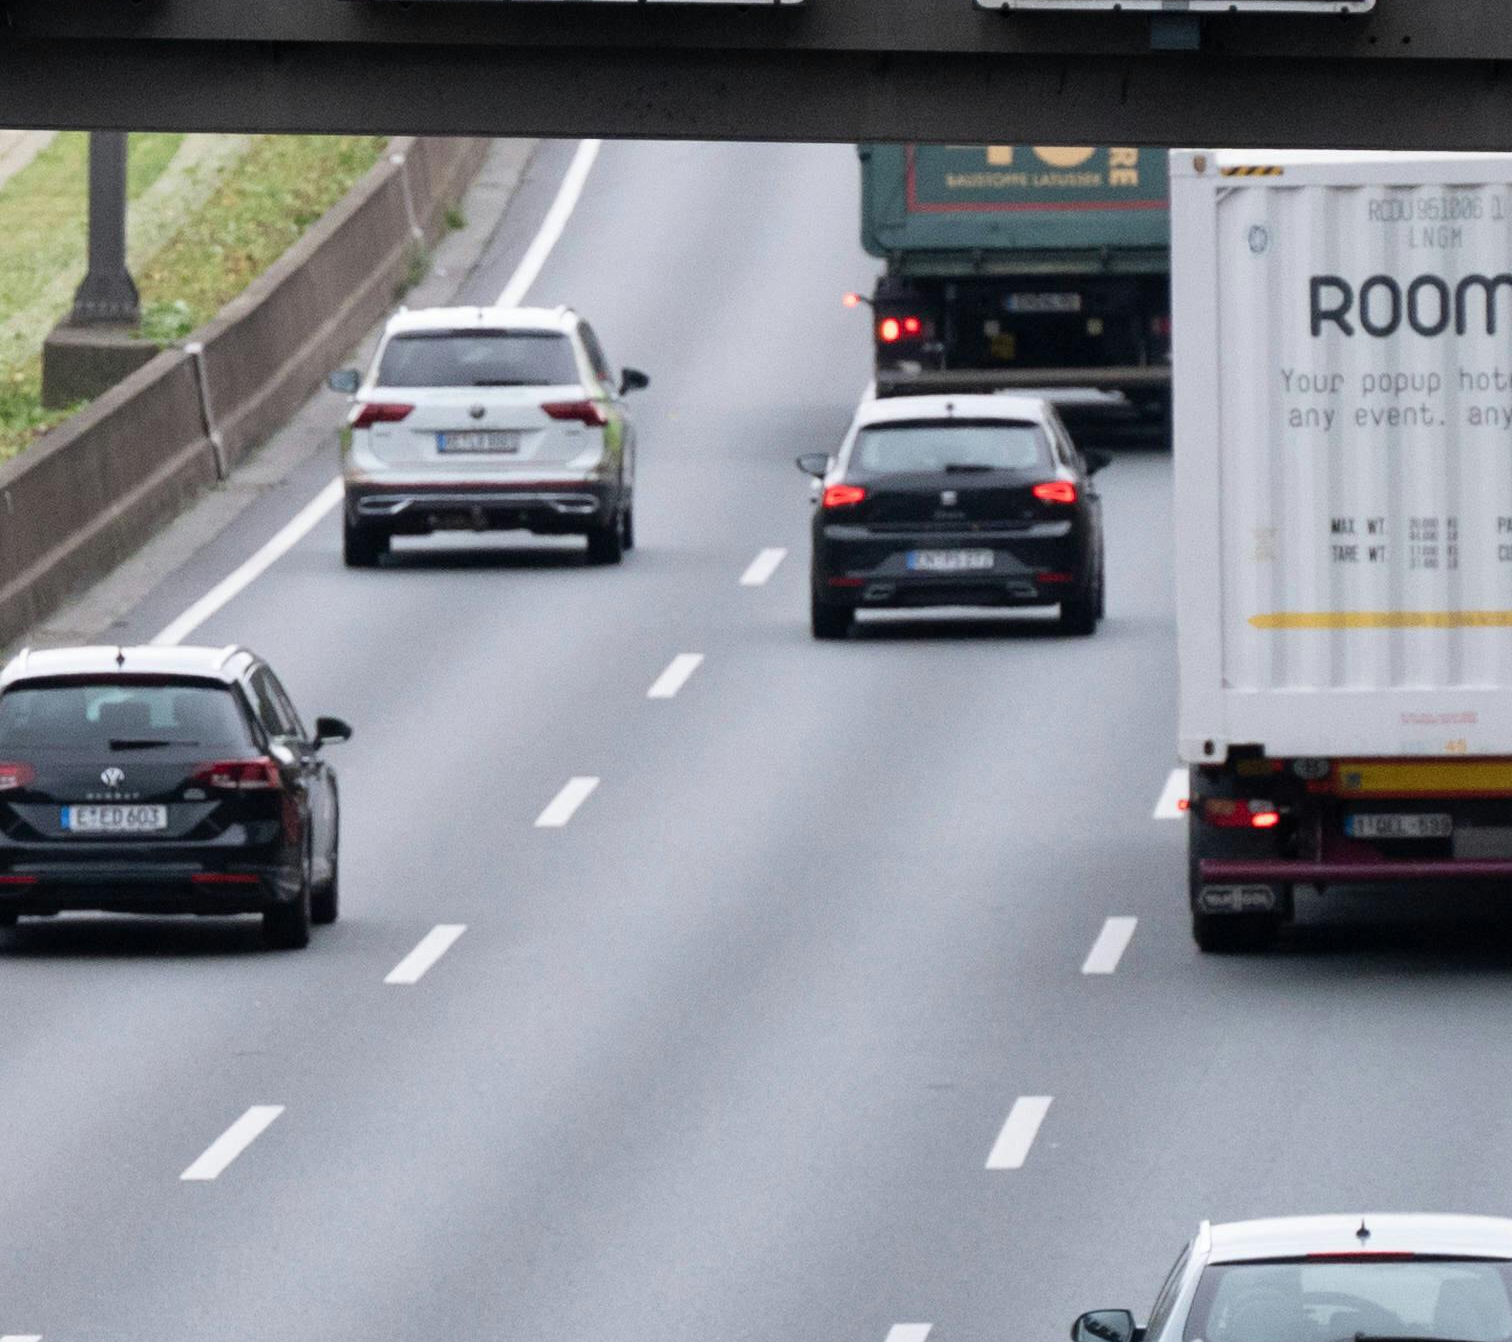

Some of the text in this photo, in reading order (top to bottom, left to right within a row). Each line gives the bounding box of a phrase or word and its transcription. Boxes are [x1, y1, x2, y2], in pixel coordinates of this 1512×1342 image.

[1281, 368, 1345, 394] Your
[1362, 371, 1442, 397] popup
[1288, 407, 1336, 431] any
